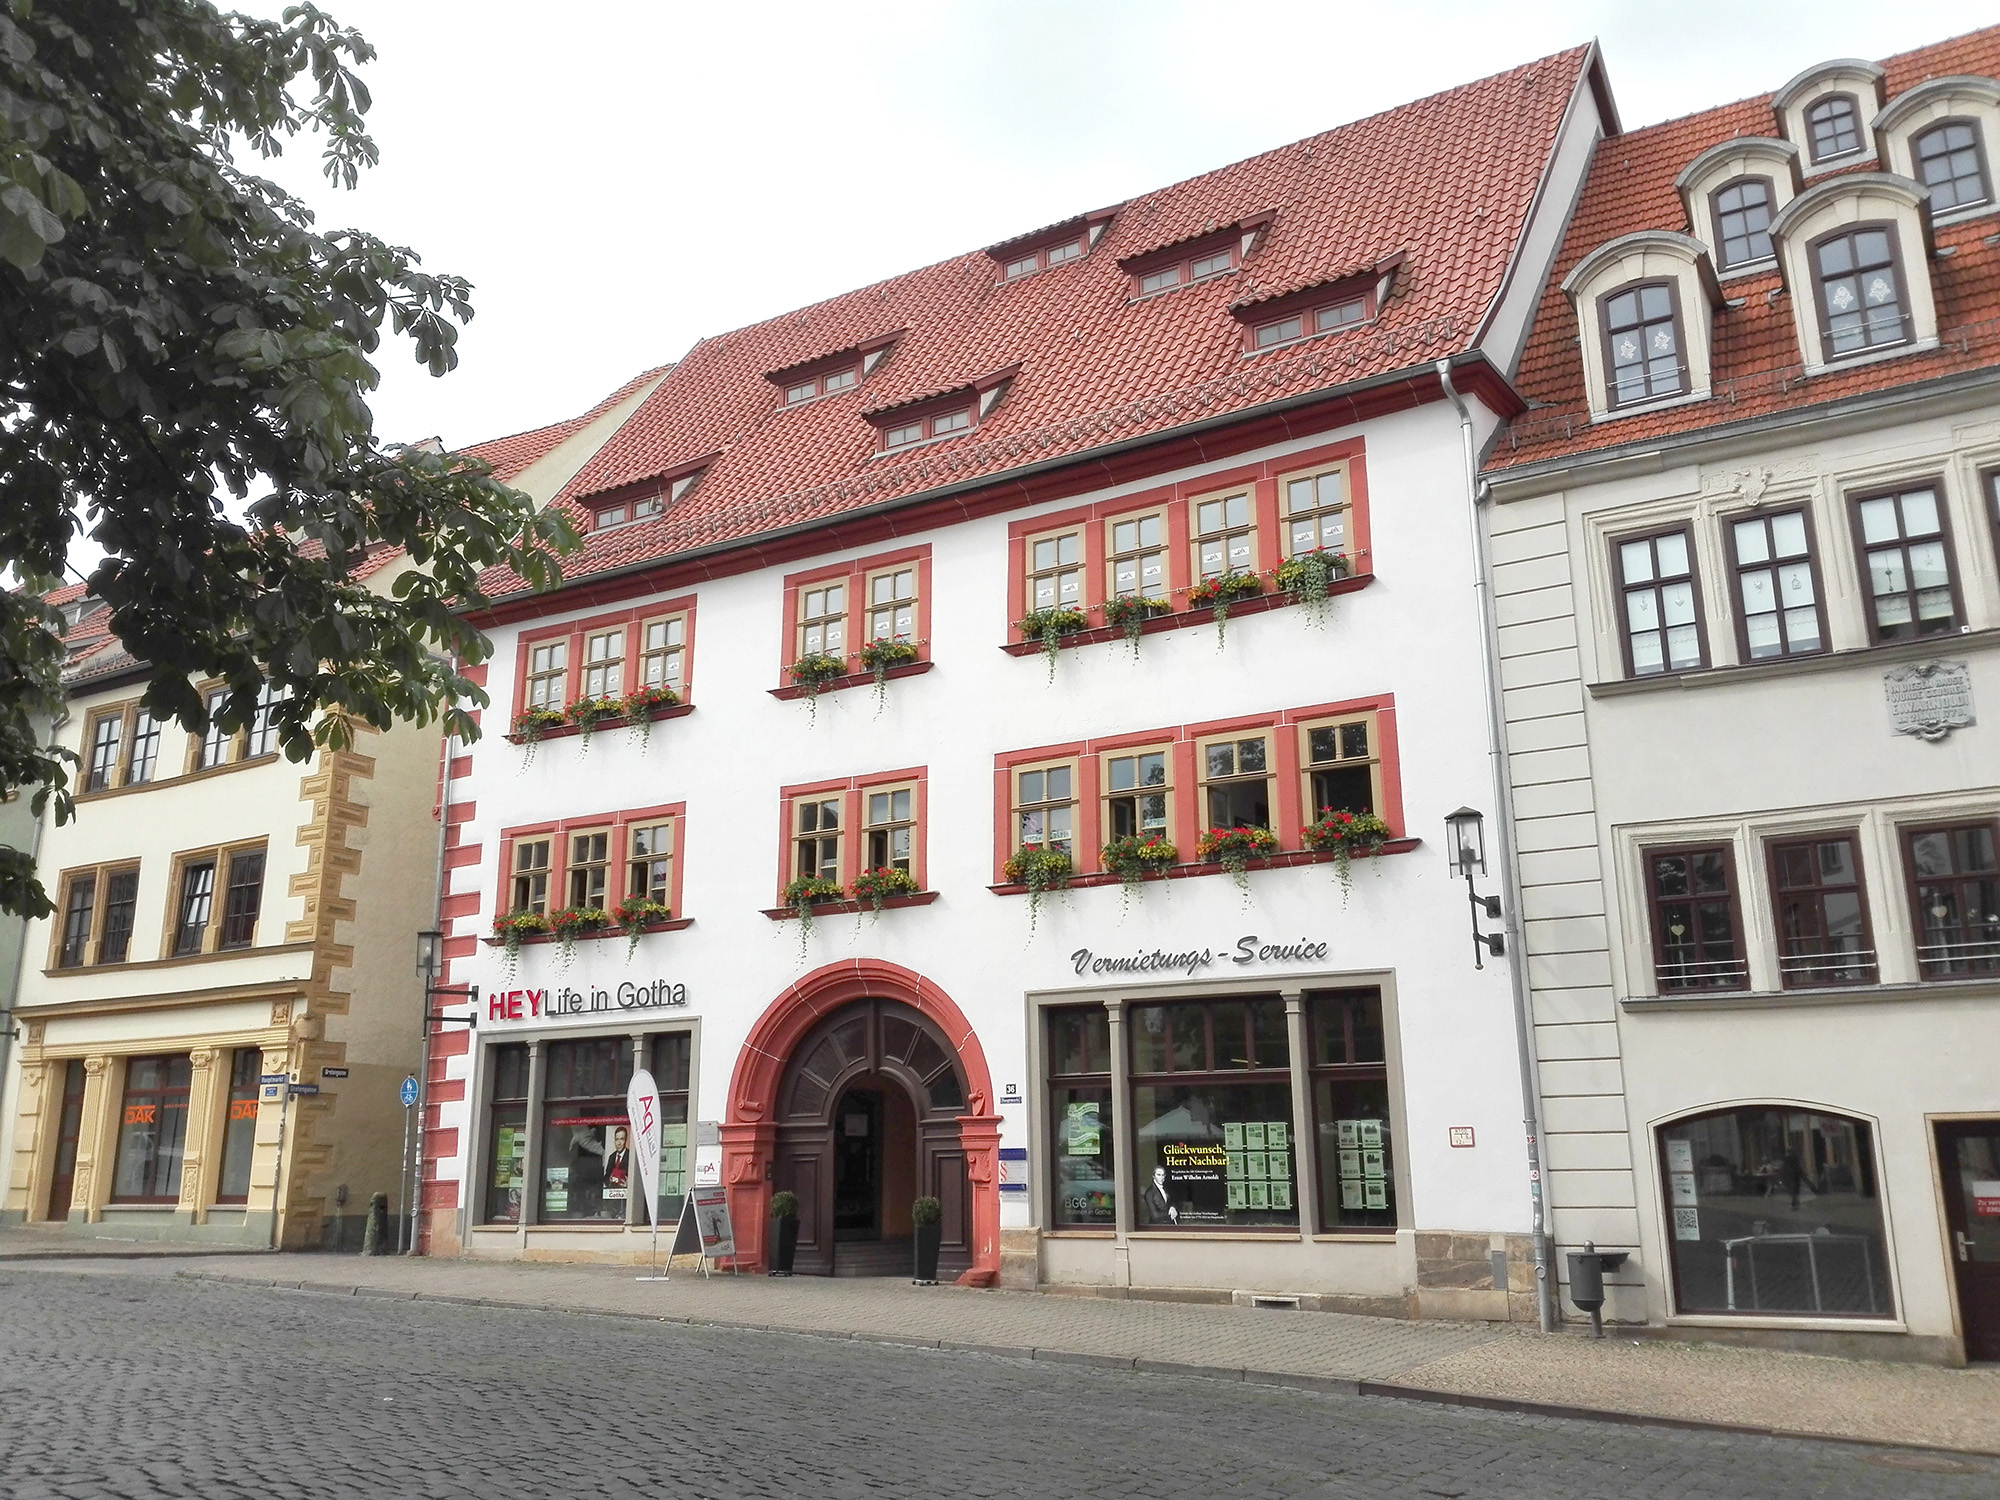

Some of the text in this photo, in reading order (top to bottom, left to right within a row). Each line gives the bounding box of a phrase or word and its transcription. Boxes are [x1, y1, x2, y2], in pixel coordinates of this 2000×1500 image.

[1936, 676, 1964, 687] HAUSE
[1892, 691, 1923, 703] WURDE
[591, 985, 608, 1011] in
[616, 978, 686, 1008] Gotha
[261, 1076, 284, 1084] Hauptmarkt
[289, 1085, 318, 1094] Gretengasse
[124, 1105, 156, 1124] DAK
[1163, 1144, 1226, 1156] Glückwunsch,
[1166, 1155, 1230, 1166] Herr Nachbar!
[1064, 1197, 1087, 1209] BGG
